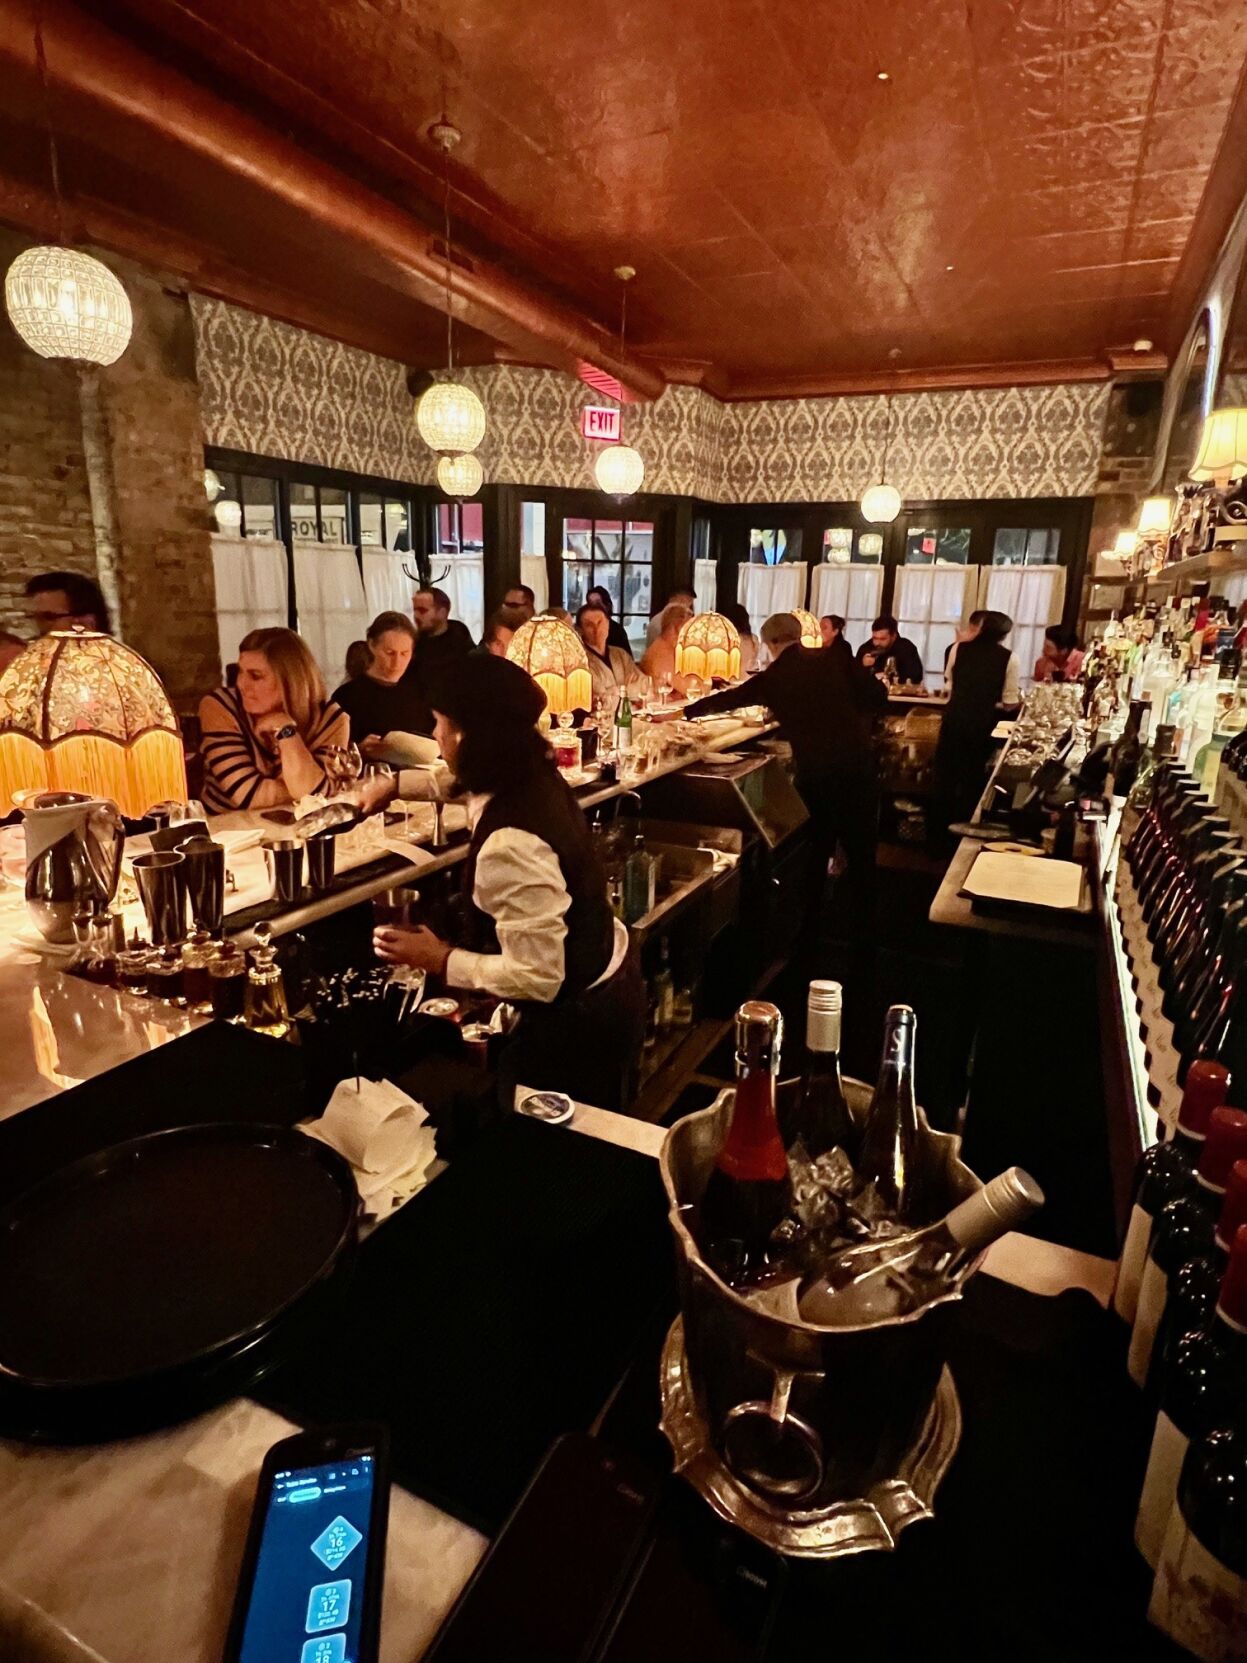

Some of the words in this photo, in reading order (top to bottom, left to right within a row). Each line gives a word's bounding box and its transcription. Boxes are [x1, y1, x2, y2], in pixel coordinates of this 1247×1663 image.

[590, 411, 614, 433] EXIT
[290, 521, 338, 536] ROYAL
[331, 1536, 344, 1548] 16
[323, 1599, 337, 1612] 17
